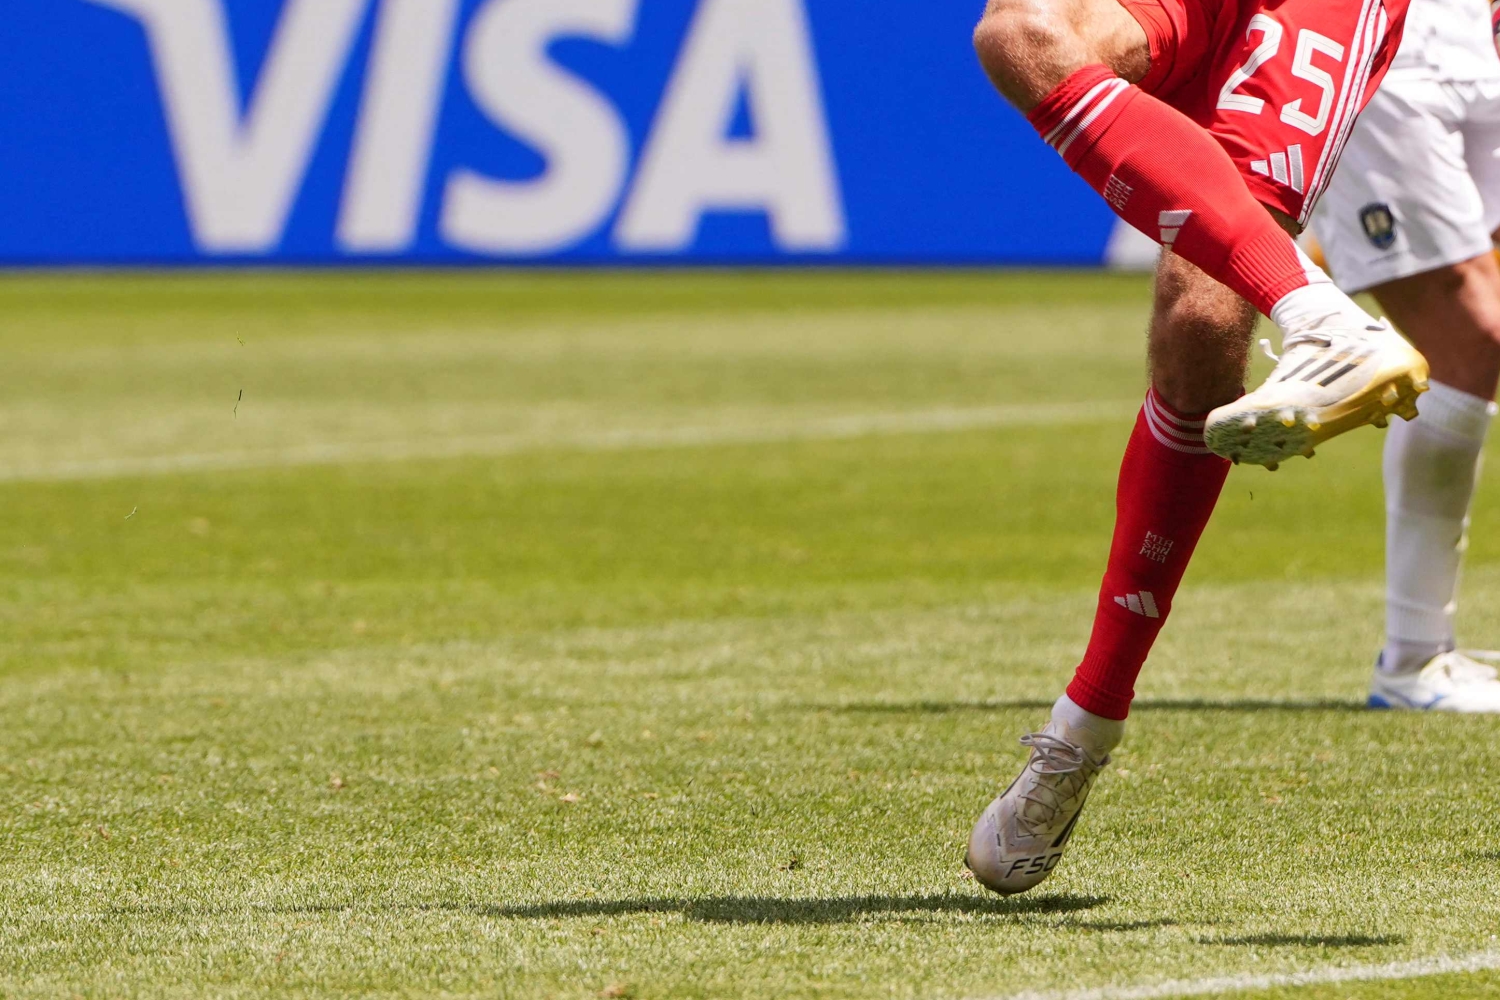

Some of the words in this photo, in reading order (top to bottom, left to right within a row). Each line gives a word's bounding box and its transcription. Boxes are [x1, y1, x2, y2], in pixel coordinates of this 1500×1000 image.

[1216, 13, 1345, 137] 25
[1142, 539, 1171, 556] SAN
[1146, 531, 1173, 548] MIA
[1139, 547, 1166, 563] MIA
[1004, 852, 1063, 879] F50
